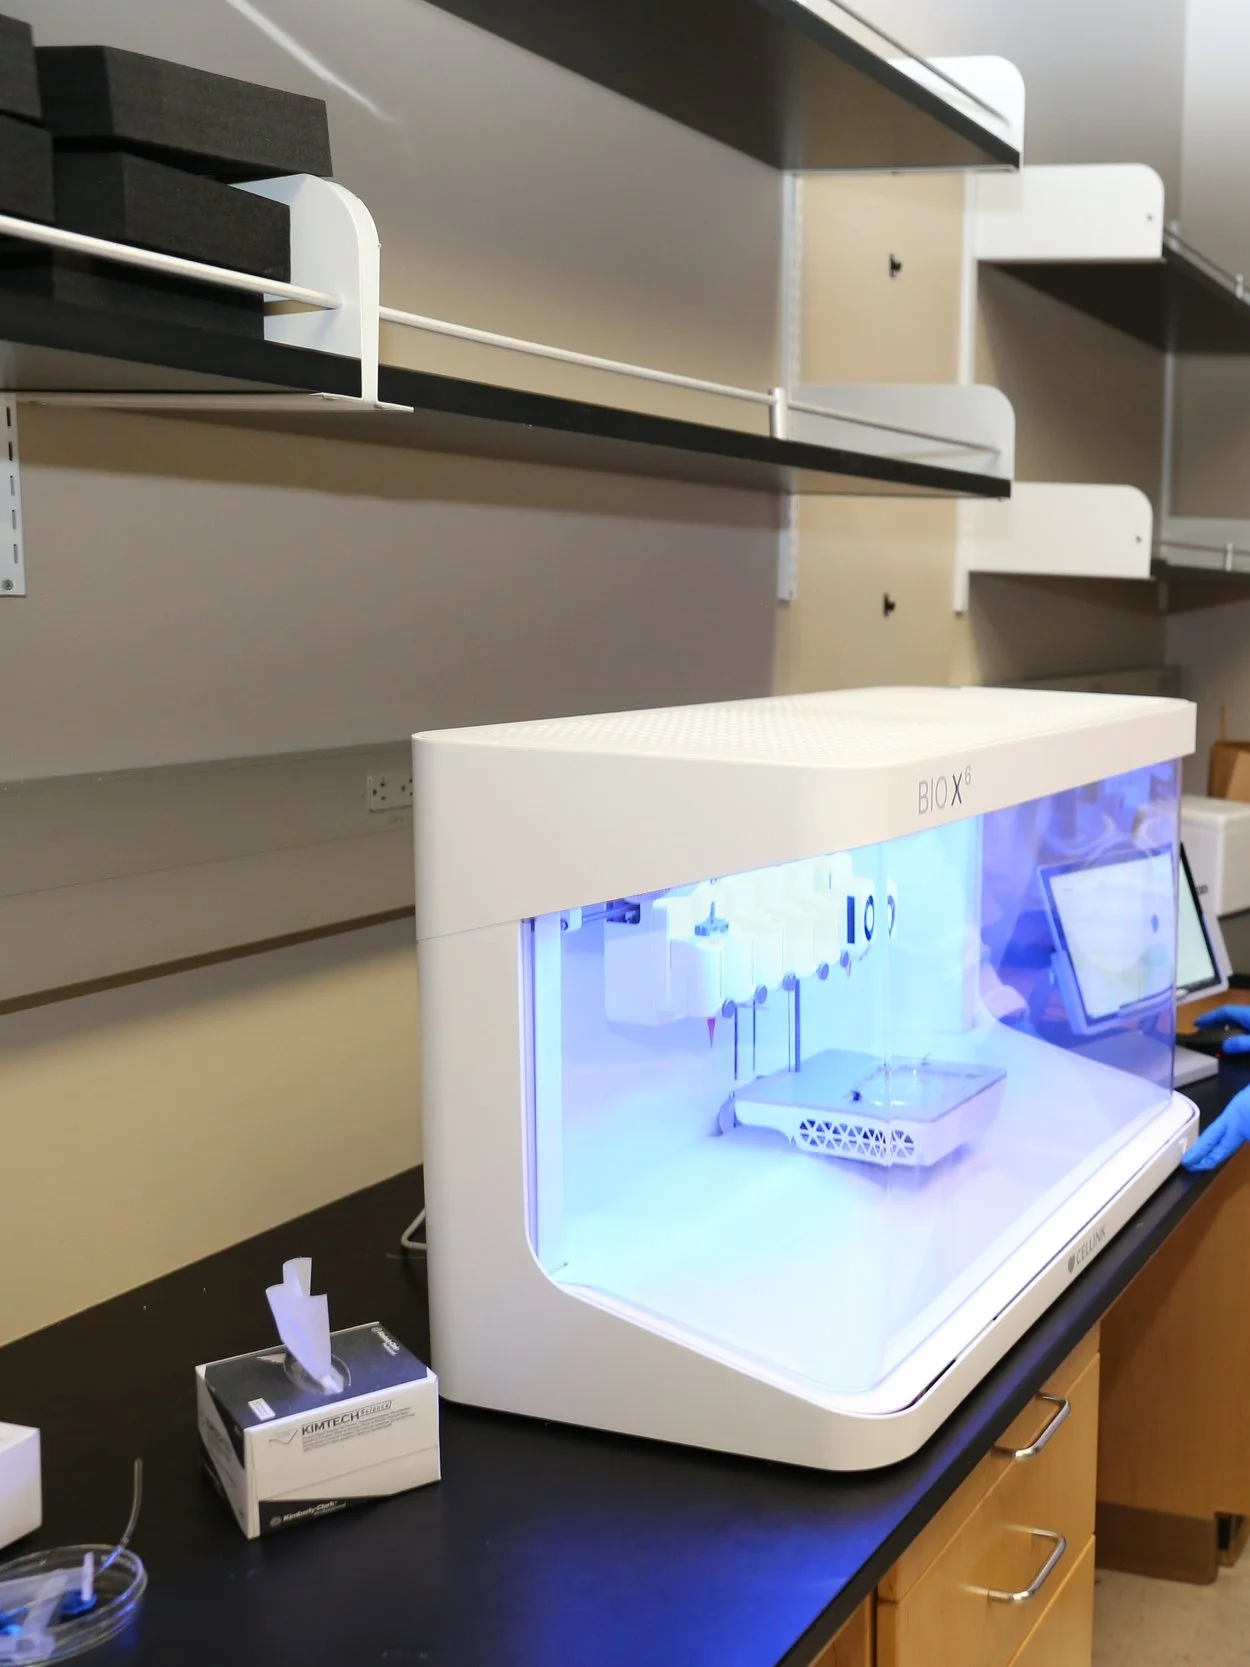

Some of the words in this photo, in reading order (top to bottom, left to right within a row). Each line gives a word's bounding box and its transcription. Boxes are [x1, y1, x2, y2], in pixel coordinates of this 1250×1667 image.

[918, 776, 948, 815] BIO
[1076, 1225, 1106, 1265] CELLINK
[301, 1411, 360, 1436] KIMTECH
